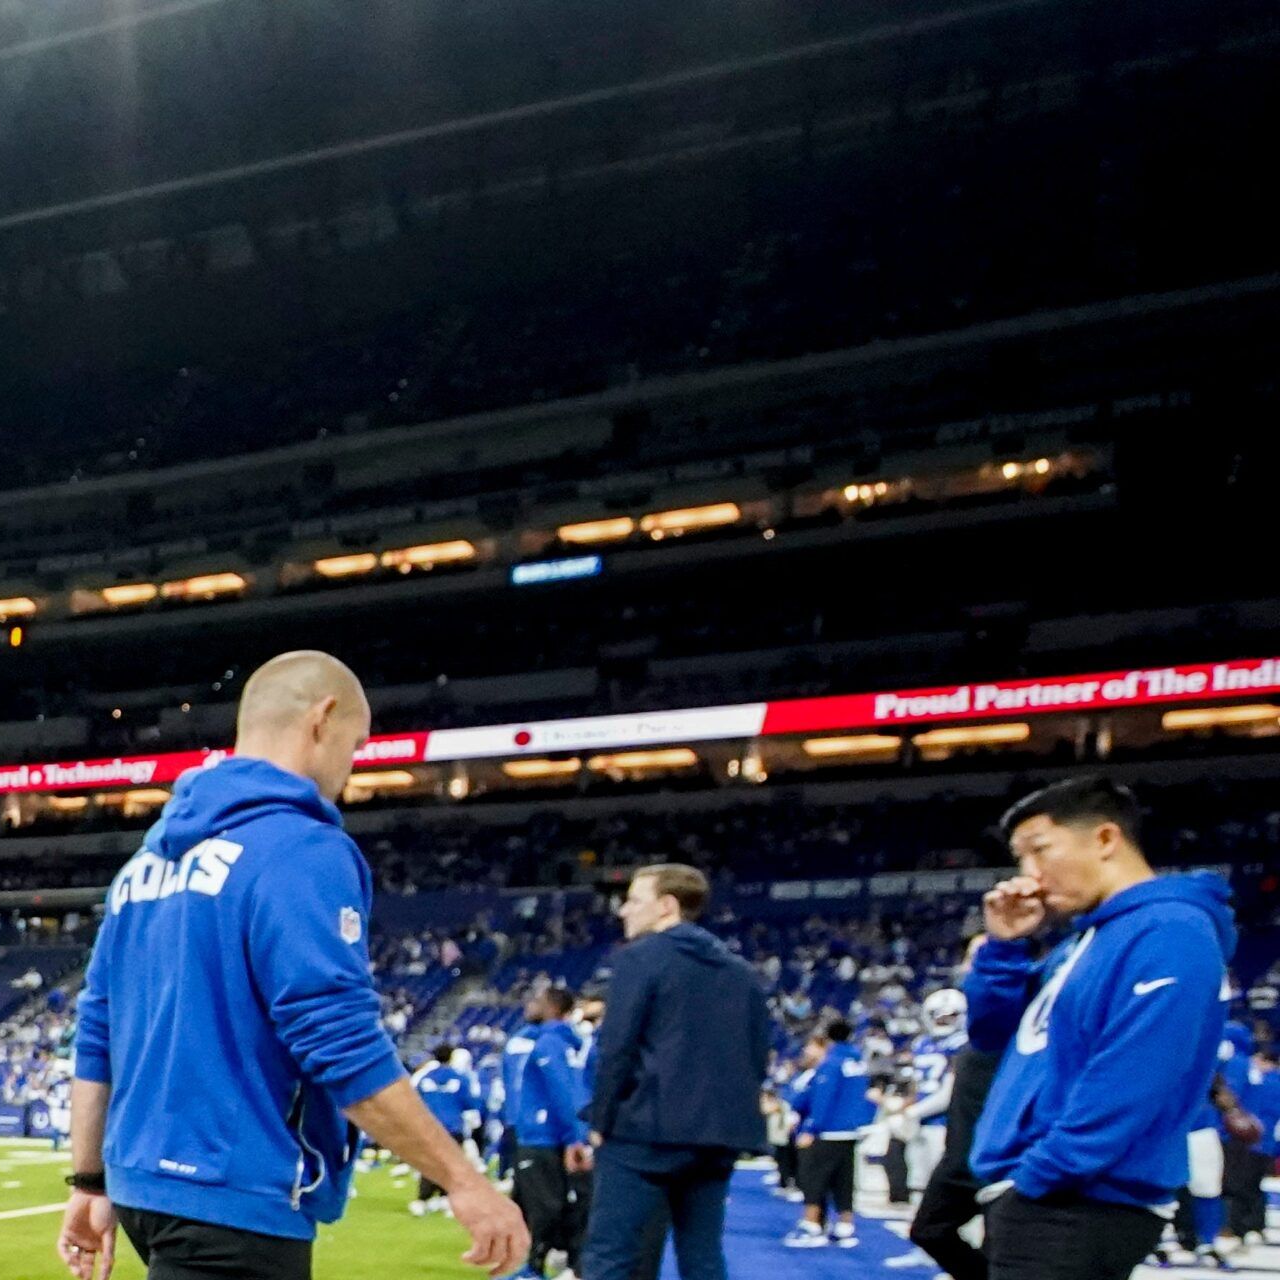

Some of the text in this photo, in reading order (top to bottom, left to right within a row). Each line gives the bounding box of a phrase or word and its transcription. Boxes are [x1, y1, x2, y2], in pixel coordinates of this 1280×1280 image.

[874, 686, 970, 719] Proud
[974, 682, 1098, 710] Partner
[1101, 670, 1141, 699] of
[1143, 667, 1206, 697] The
[42, 758, 158, 785] Technology
